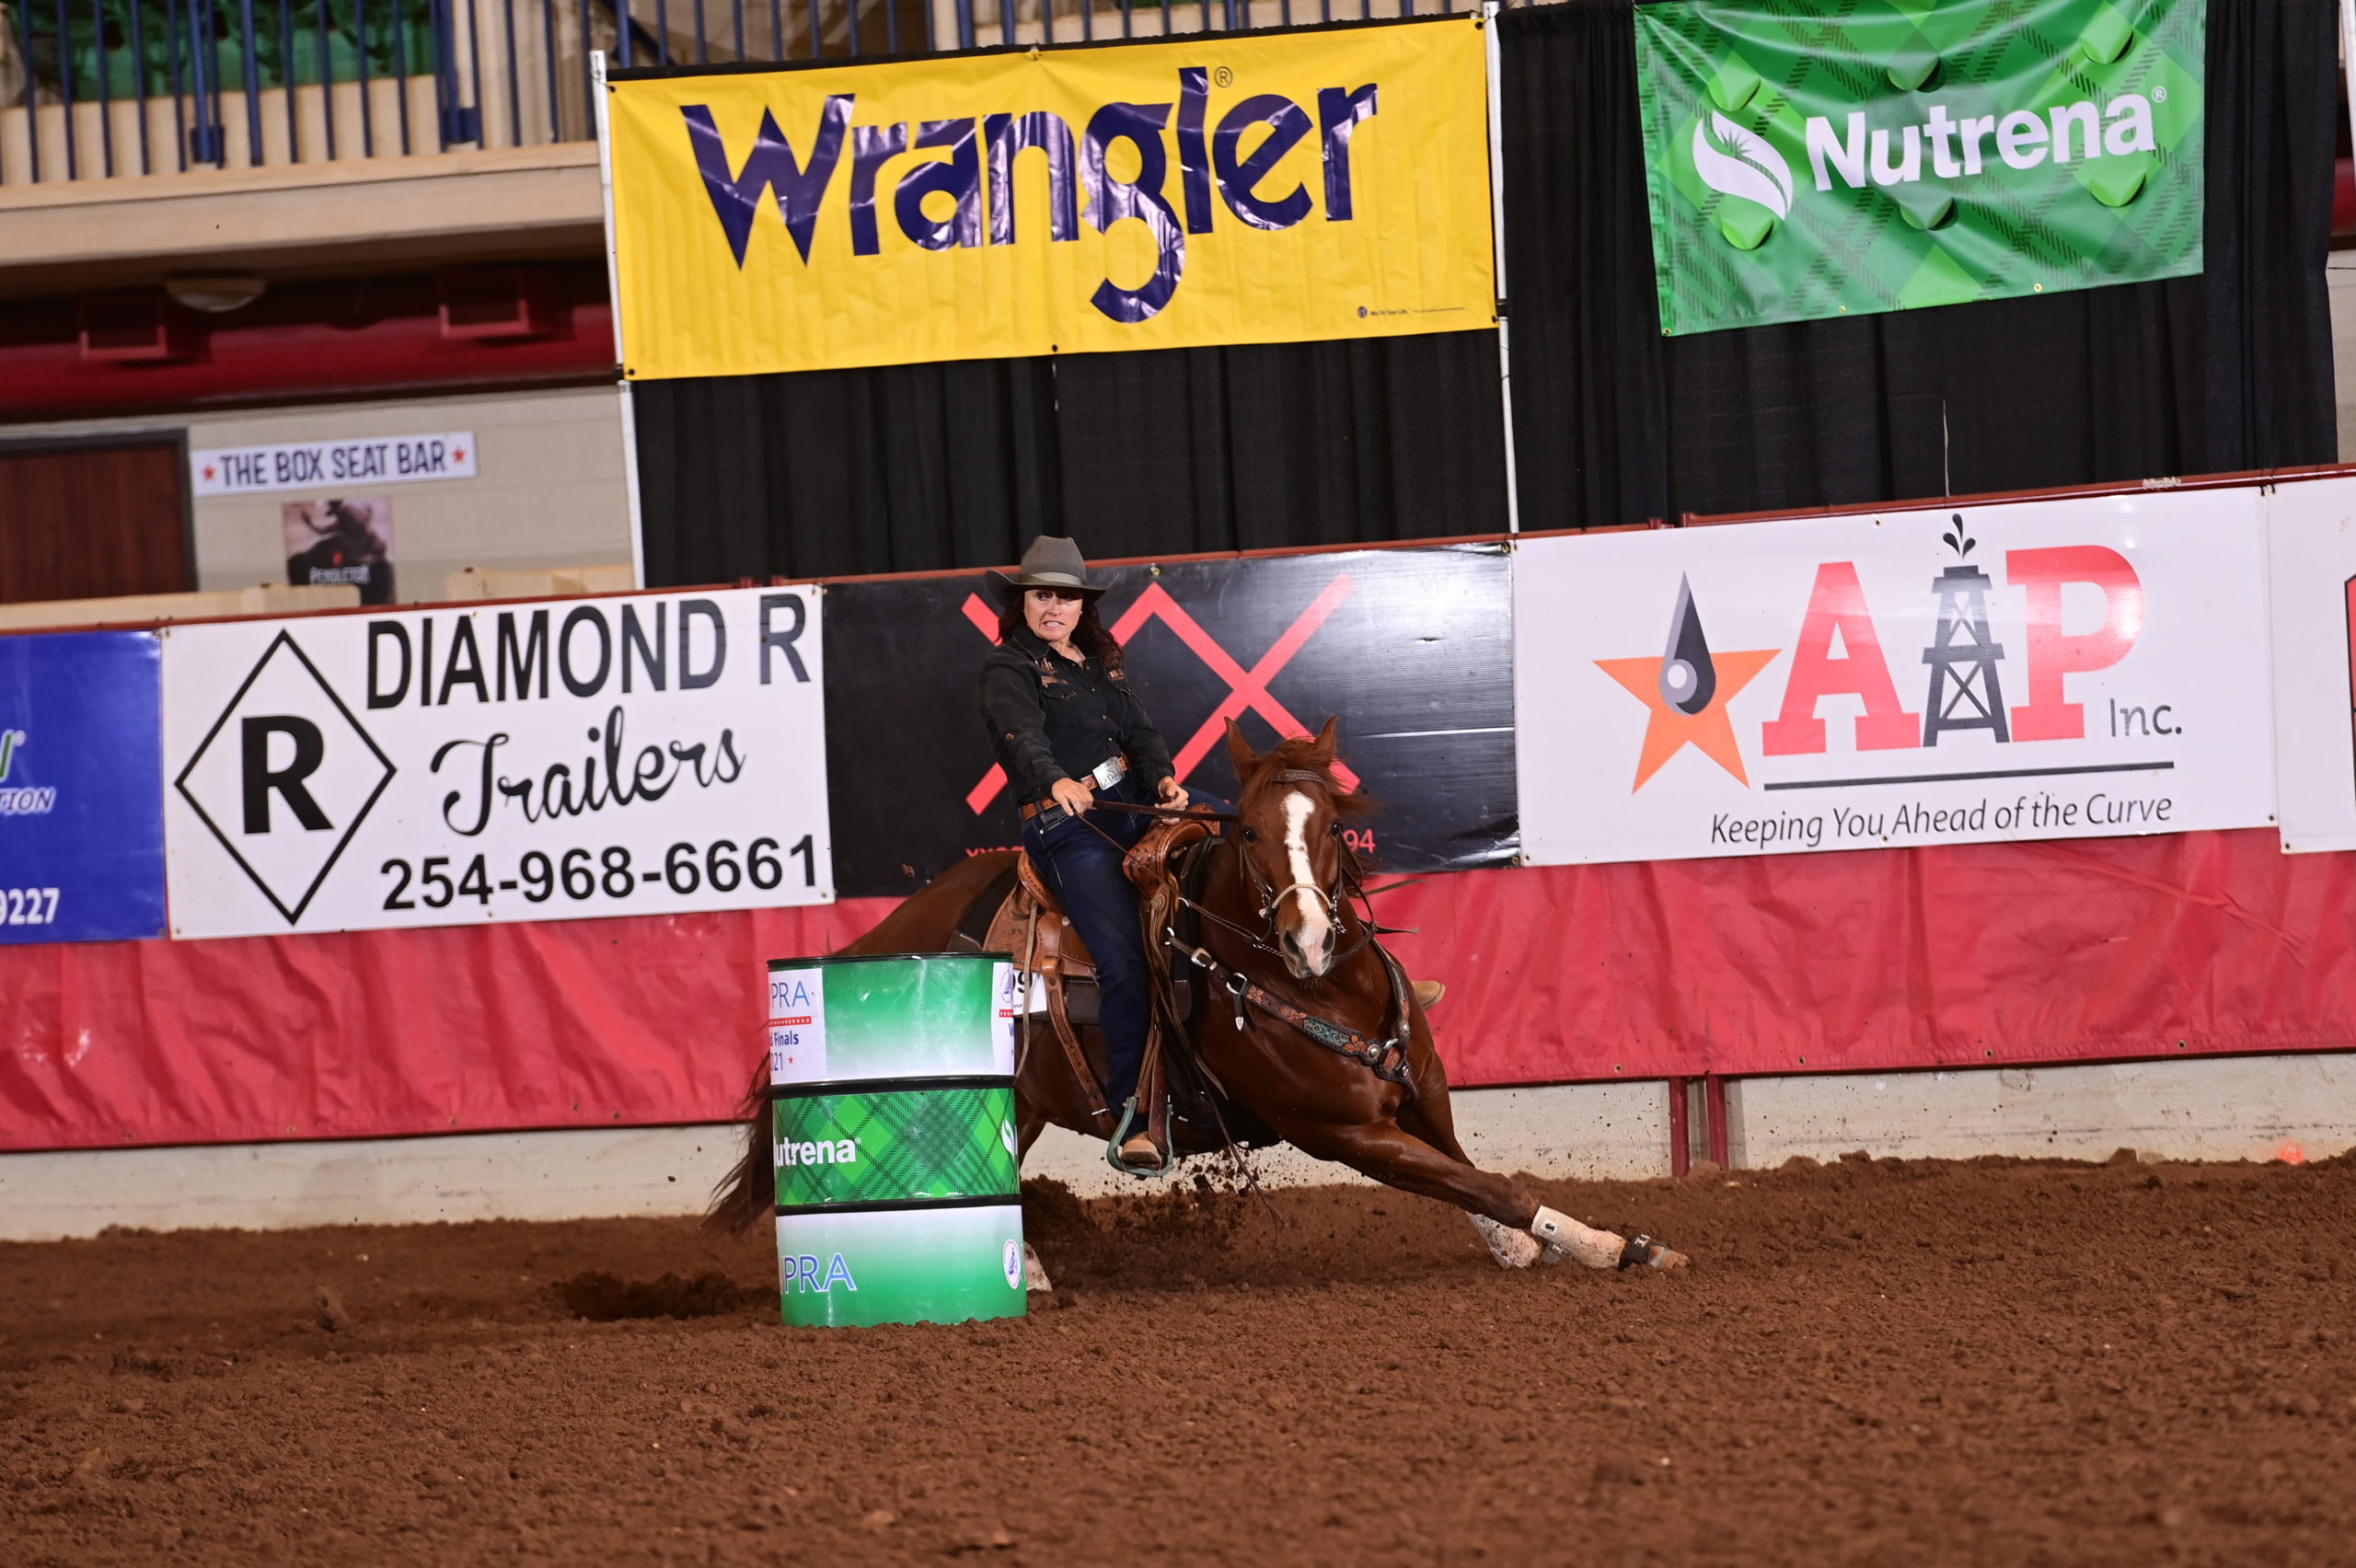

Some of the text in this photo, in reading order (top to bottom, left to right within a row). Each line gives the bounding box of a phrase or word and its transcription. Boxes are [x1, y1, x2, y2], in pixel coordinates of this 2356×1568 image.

[1805, 94, 2155, 191] Nutrena
[680, 66, 1378, 323] Wrangler
[221, 440, 446, 486] THE BOX SEAT BAR
[367, 594, 812, 710] DIAMOND R
[2109, 698, 2183, 738] Inc.
[241, 713, 335, 835] R
[430, 705, 746, 836] Trailers
[1711, 793, 2172, 850] Keeping You Ahead of the Curve
[380, 834, 817, 911] 254-968-6661
[774, 1031, 800, 1045] Finals
[774, 1136, 857, 1168] utrena
[780, 1251, 858, 1295] PRA
